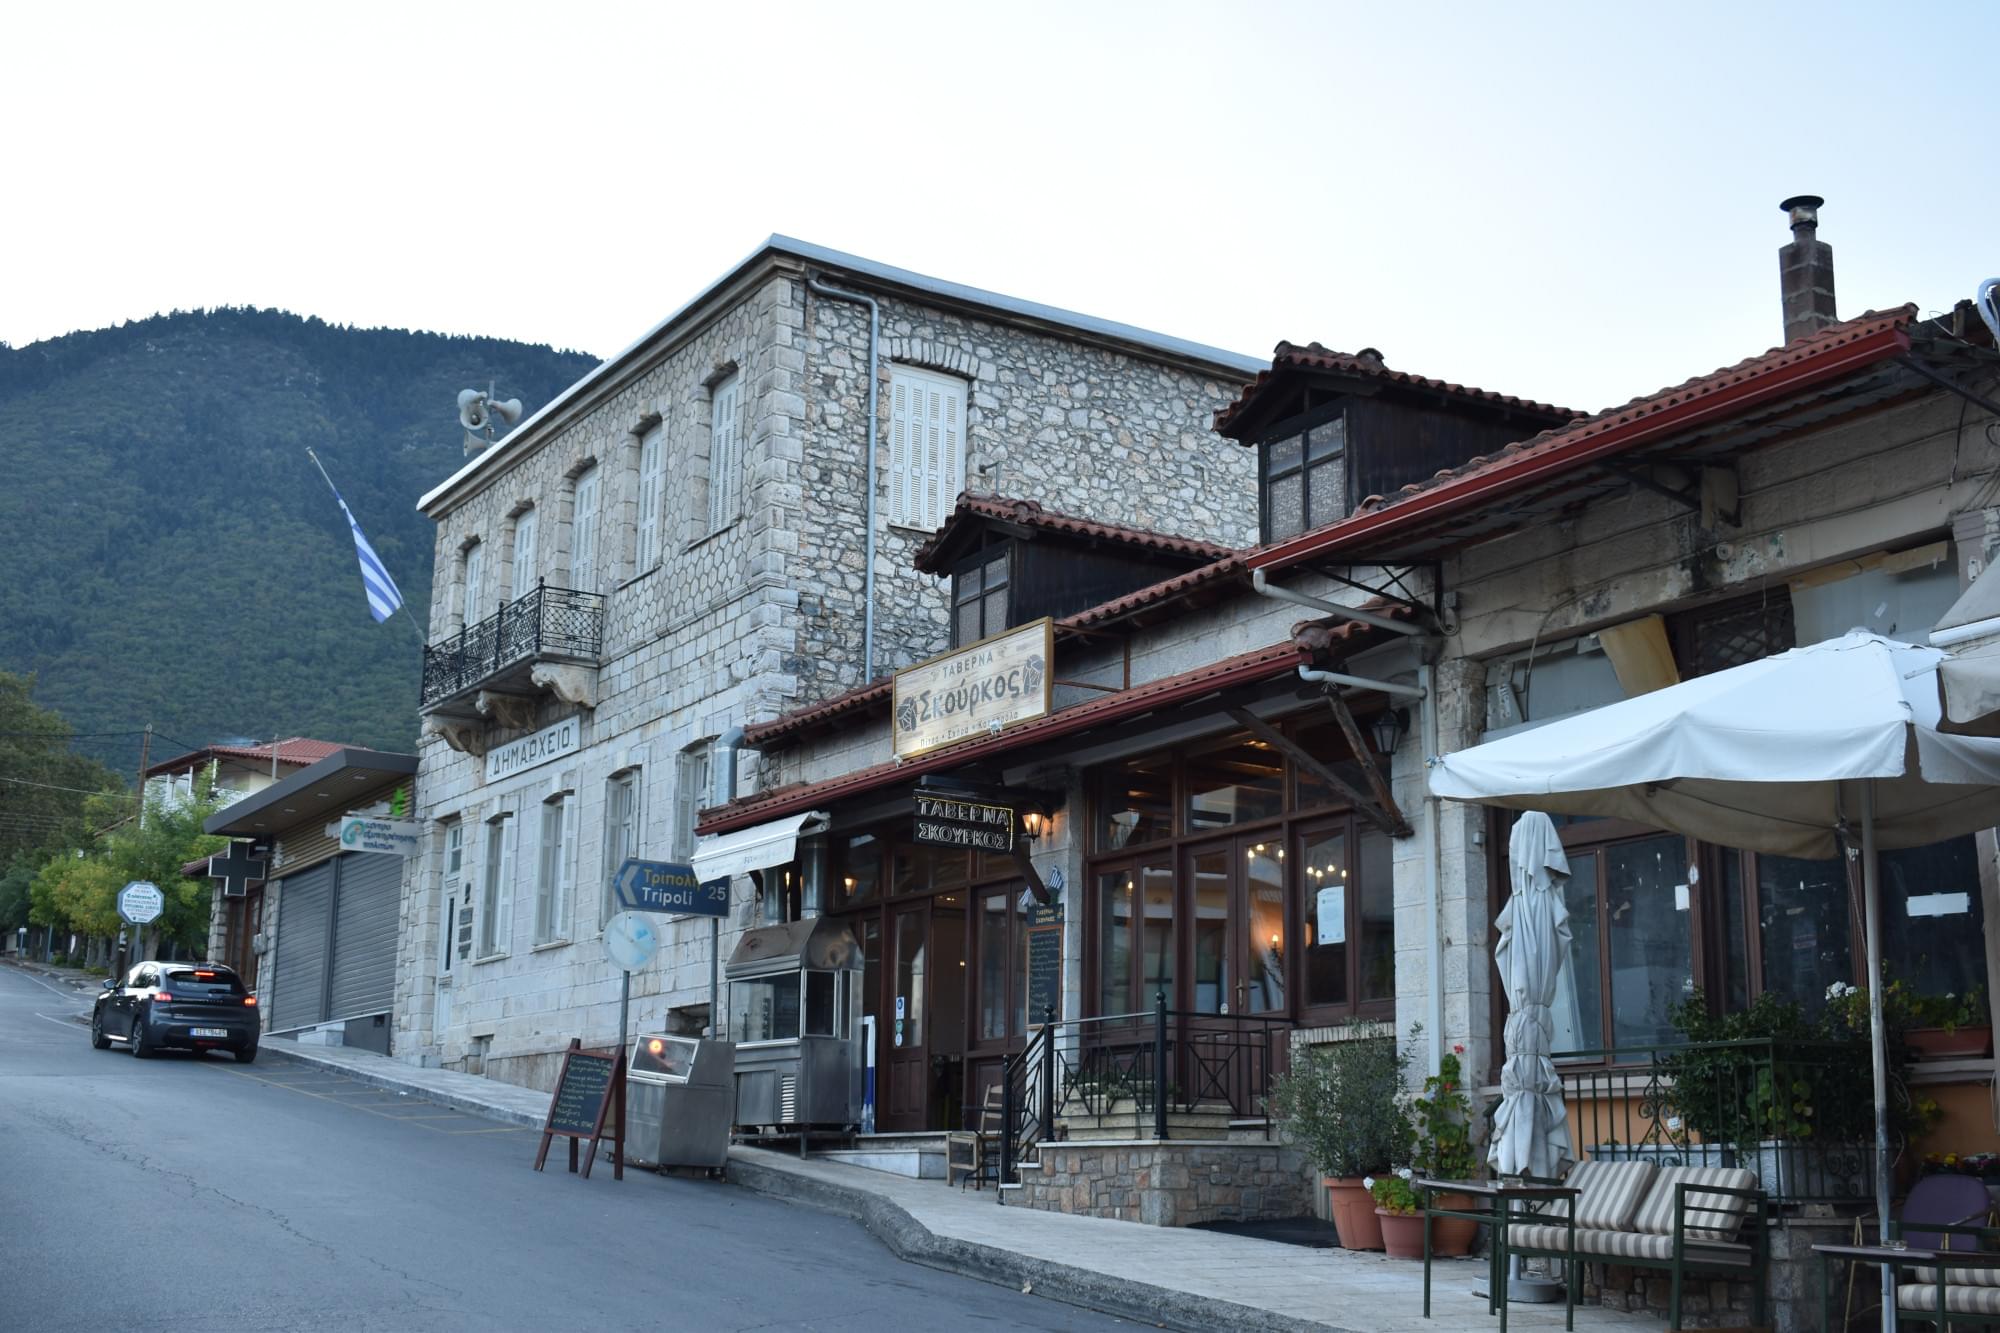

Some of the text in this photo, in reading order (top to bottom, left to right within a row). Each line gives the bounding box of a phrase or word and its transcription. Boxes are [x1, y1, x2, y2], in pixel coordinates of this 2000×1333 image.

[943, 651, 993, 678] ΤΑΒΕΡΝΑ
[919, 670, 1020, 722] Σκούρκος
[493, 726, 570, 775] ΔΗΜΑΡΧΕΙΟ
[918, 799, 1009, 827] ΤΑΒΕΡΝΑ
[918, 822, 1006, 849] ΣΚΟΥΡΚΟΣ
[642, 886, 726, 906] Tripoli 25
